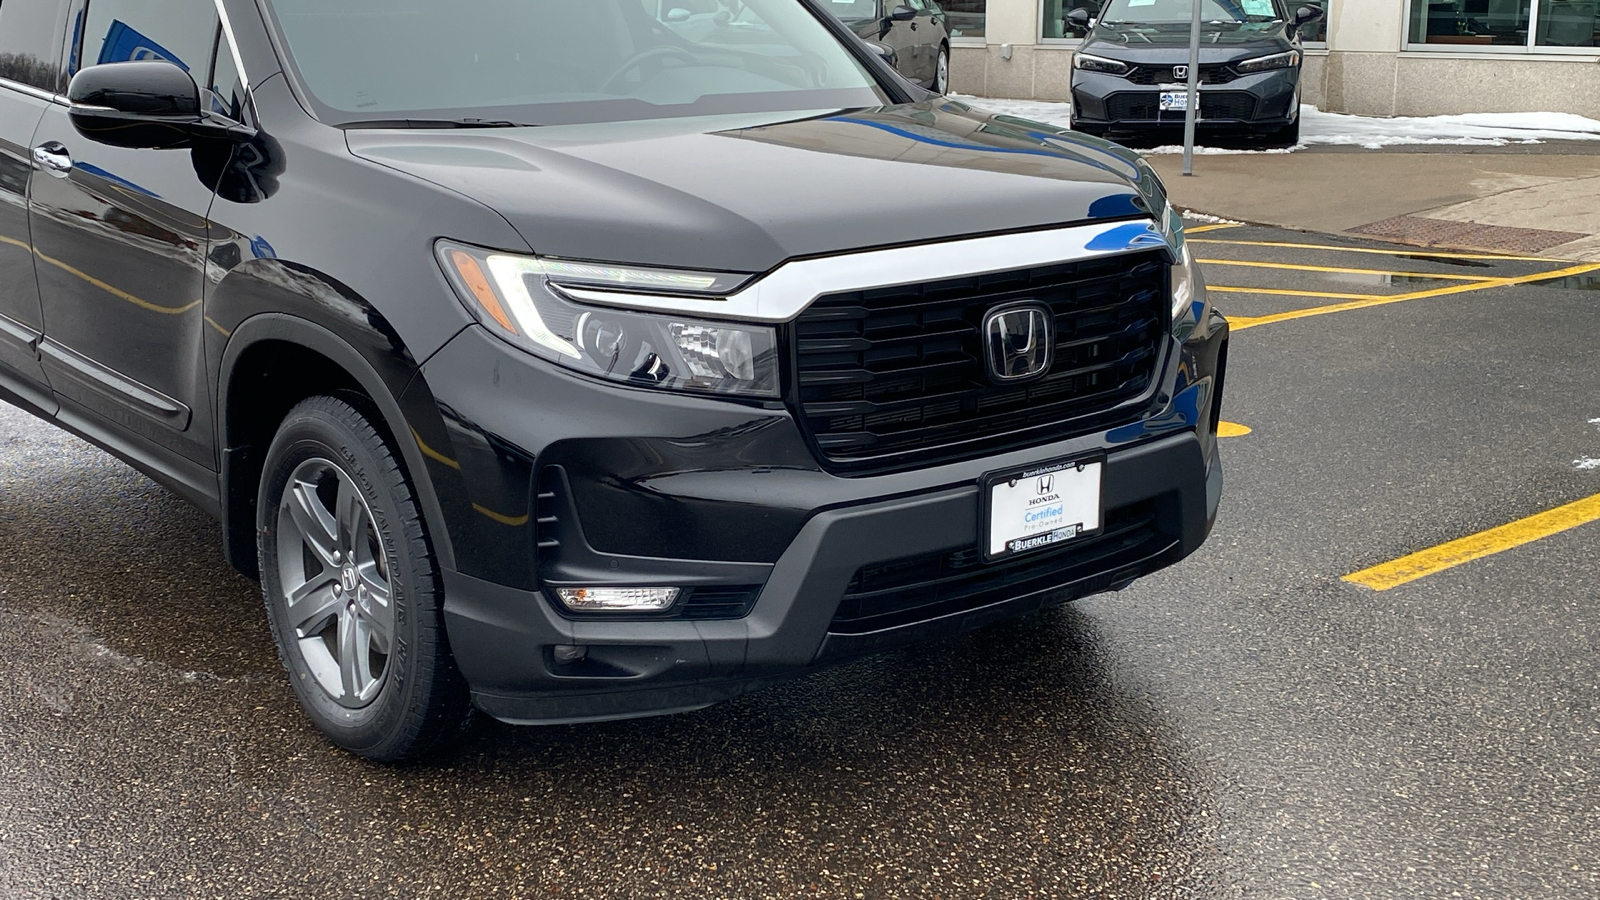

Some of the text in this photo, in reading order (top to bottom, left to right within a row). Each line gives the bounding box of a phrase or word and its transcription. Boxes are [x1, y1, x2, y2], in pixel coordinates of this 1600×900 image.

[1022, 462, 1076, 478] buerklehonda.com
[1028, 494, 1060, 506] HONDA
[1024, 504, 1063, 522] Certified
[1024, 518, 1063, 531] Pre-Owned
[1014, 534, 1052, 550] BUERKLE
